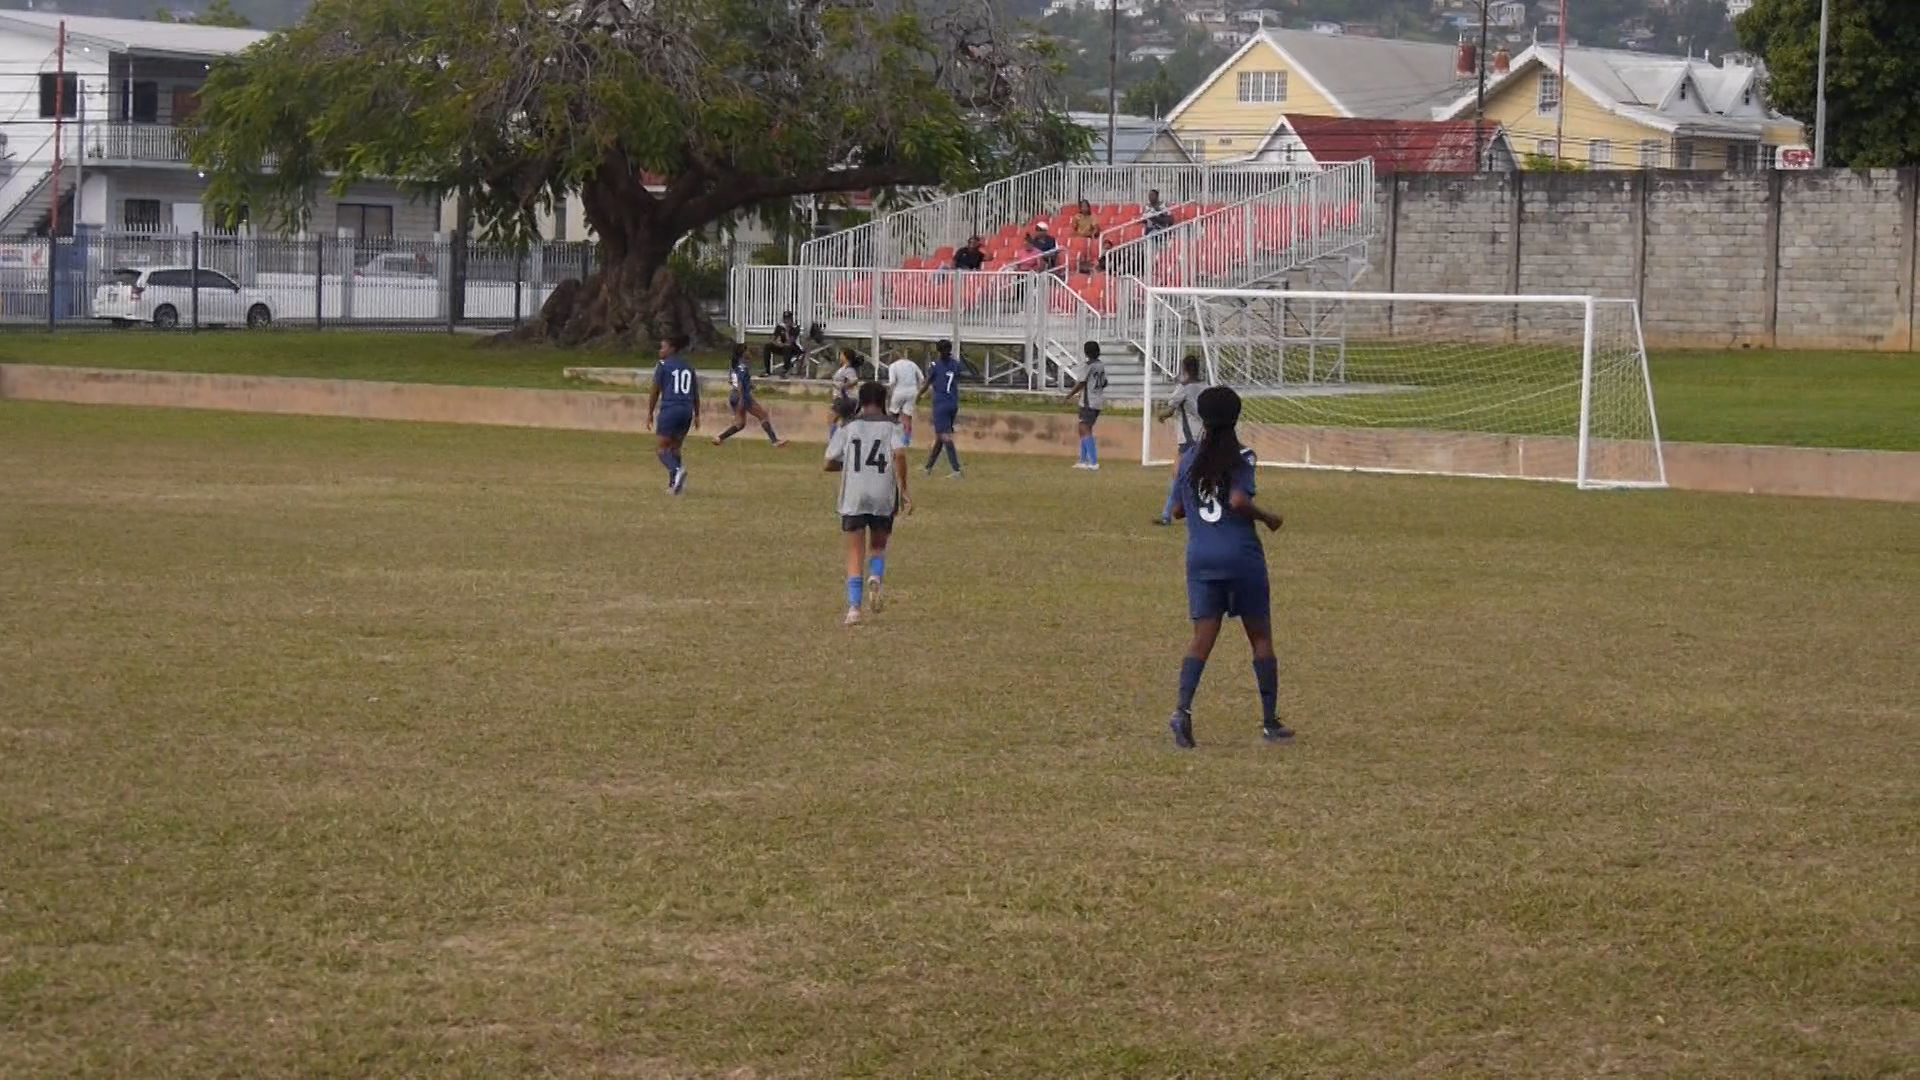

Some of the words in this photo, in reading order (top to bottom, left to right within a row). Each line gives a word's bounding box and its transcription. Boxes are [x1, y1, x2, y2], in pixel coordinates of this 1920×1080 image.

[671, 369, 692, 394] 10
[945, 371, 955, 394] 7
[852, 439, 888, 474] 14
